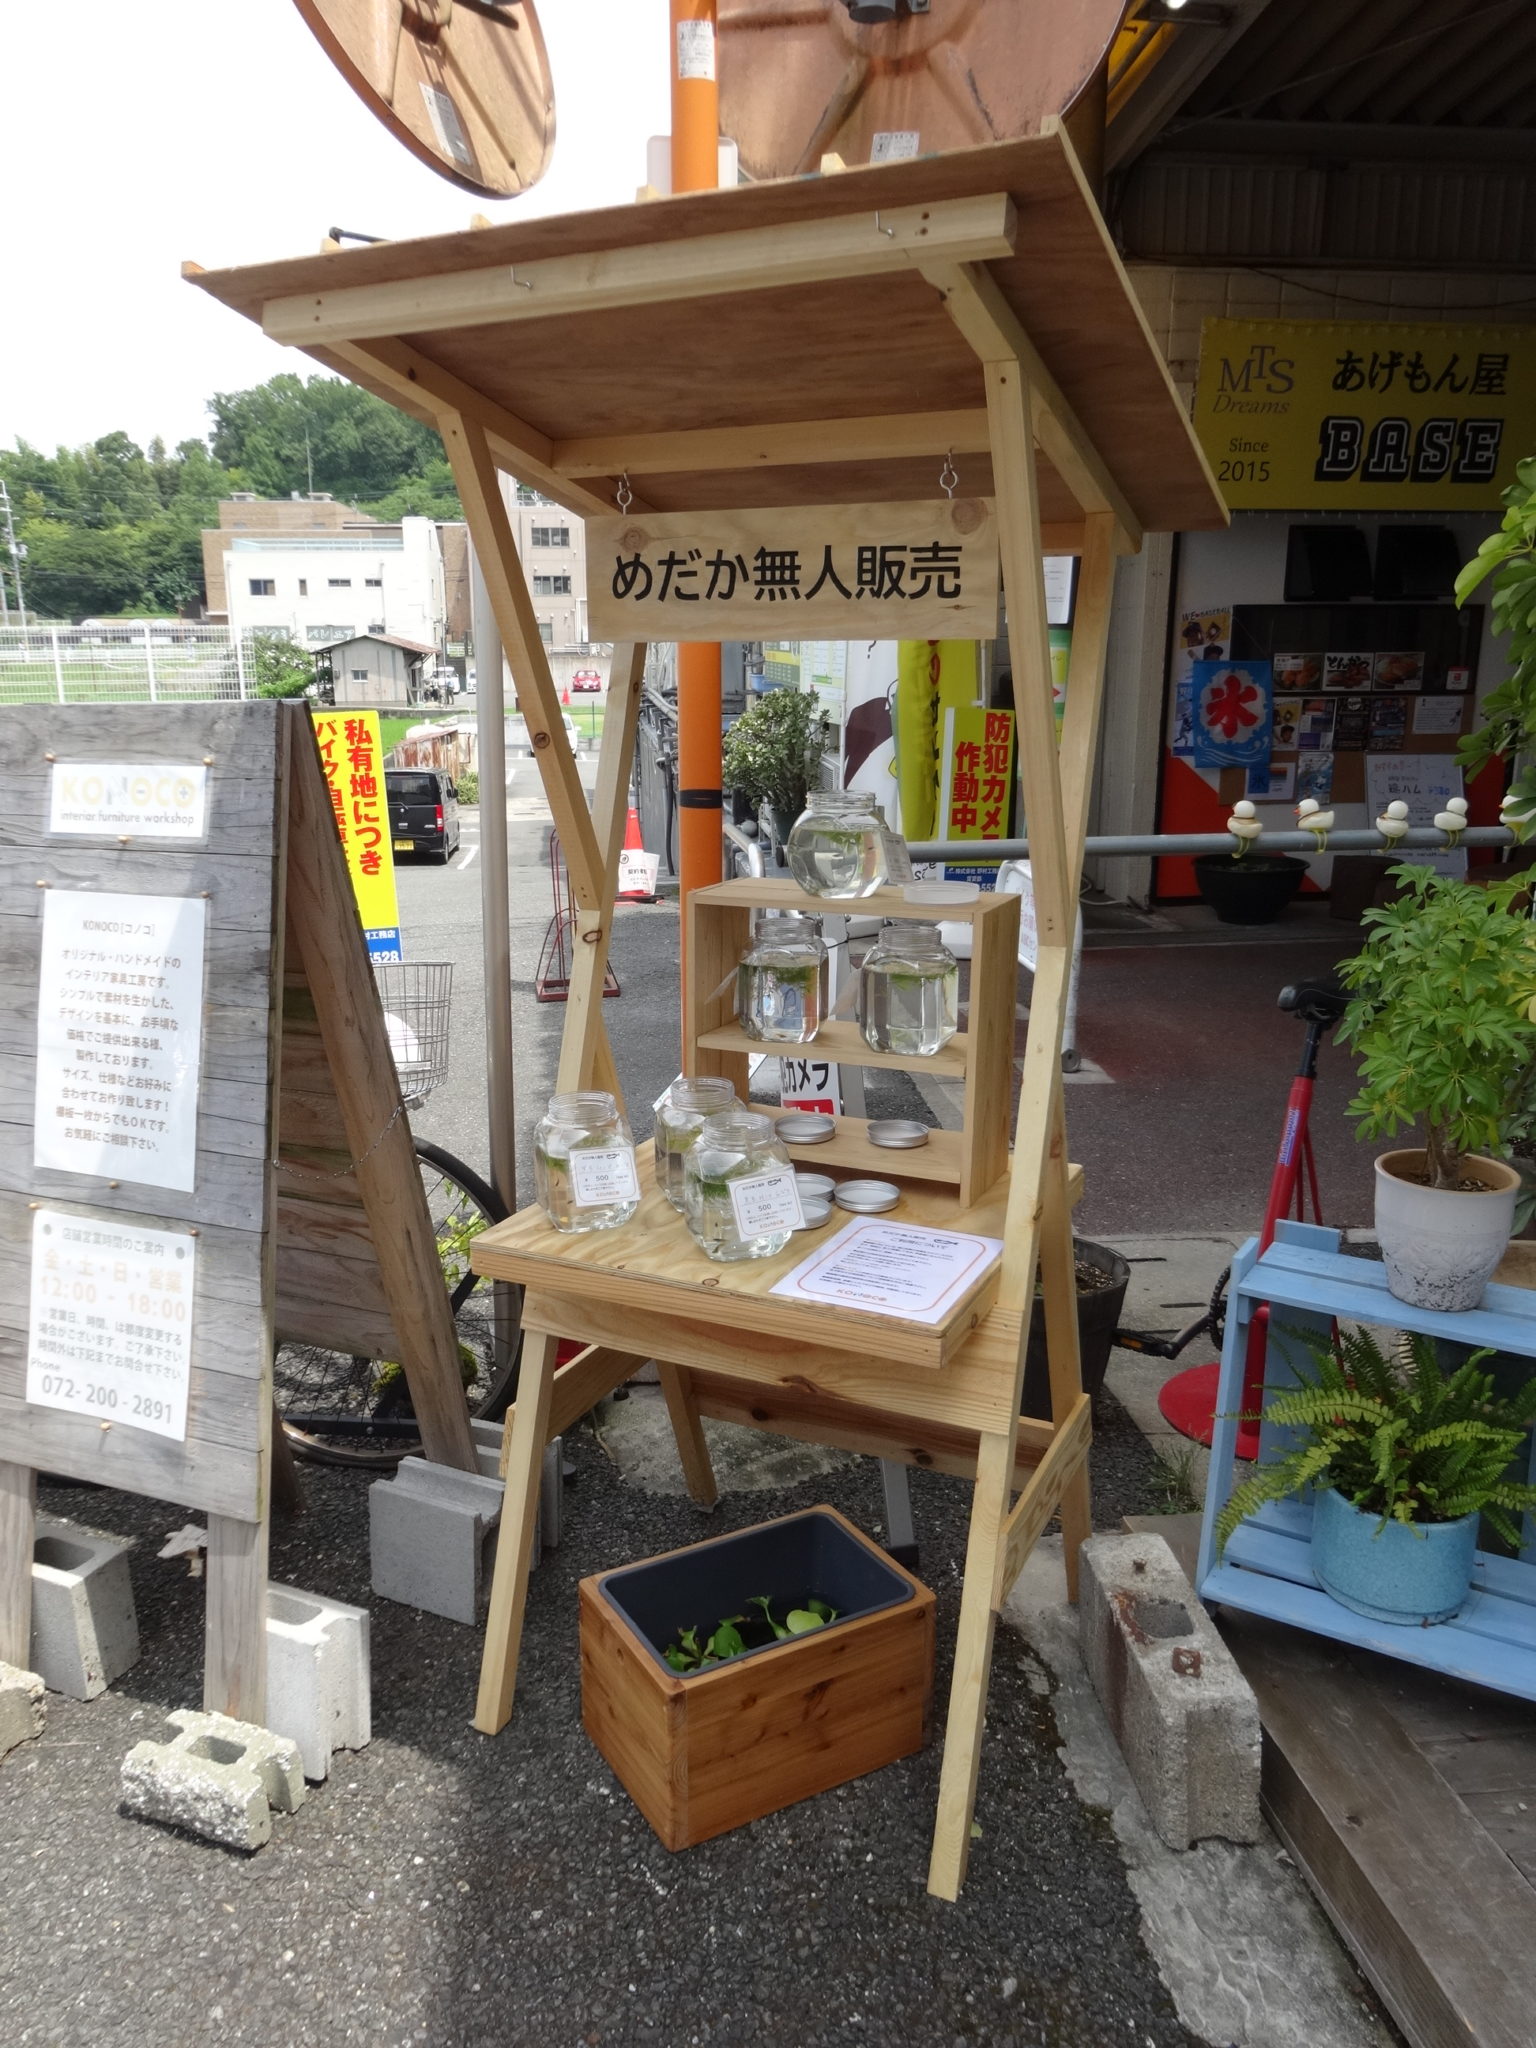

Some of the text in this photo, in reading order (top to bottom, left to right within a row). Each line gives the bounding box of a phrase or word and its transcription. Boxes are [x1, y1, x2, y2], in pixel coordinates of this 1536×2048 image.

[1217, 345, 1295, 394] MTS
[1332, 350, 1510, 395] あげもん屋
[1212, 395, 1289, 415] Dreams
[1228, 438, 1269, 454] Since
[1314, 415, 1504, 483] BASE
[1218, 460, 1270, 482] 2015
[611, 540, 962, 602] めだか無人販売
[1206, 674, 1258, 739] 氷
[61, 777, 196, 809] KONOCO
[344, 719, 383, 876] 私有地につき
[951, 741, 981, 834] 作動中
[981, 712, 1011, 840] 防犯カメ
[60, 810, 194, 827] interior furniture workshop
[758, 1203, 772, 1212] 500
[40, 1275, 97, 1304] 12:00
[128, 1292, 186, 1322] 18:00
